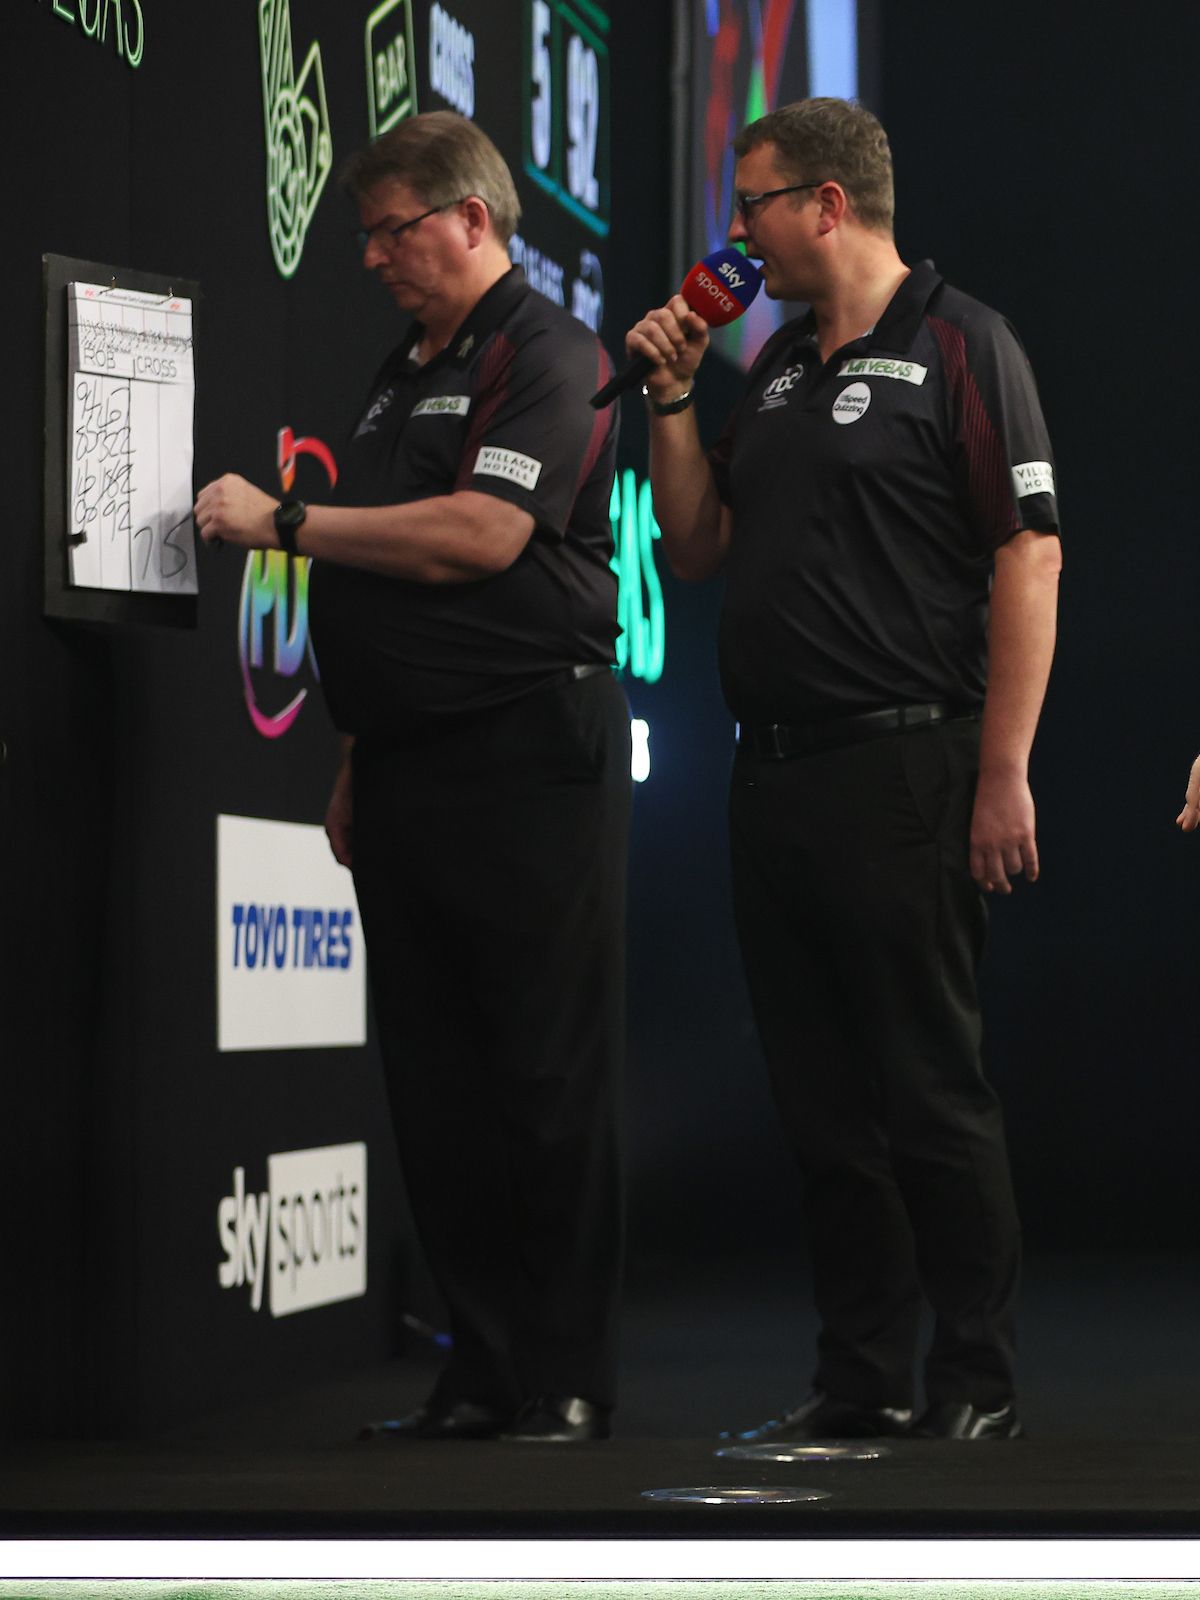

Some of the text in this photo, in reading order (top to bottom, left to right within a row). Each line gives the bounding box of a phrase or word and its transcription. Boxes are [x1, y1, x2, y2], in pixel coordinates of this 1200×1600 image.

[376, 34, 408, 111] BAR
[567, 34, 598, 211] 92
[695, 271, 735, 313] sports
[717, 262, 745, 289] sky
[83, 348, 178, 379] ROB CROSS
[867, 361, 914, 378] VEGAS
[484, 451, 537, 473] VILLAGE
[233, 904, 352, 969] TOYO TIRES
[218, 1166, 358, 1311] sky sports
